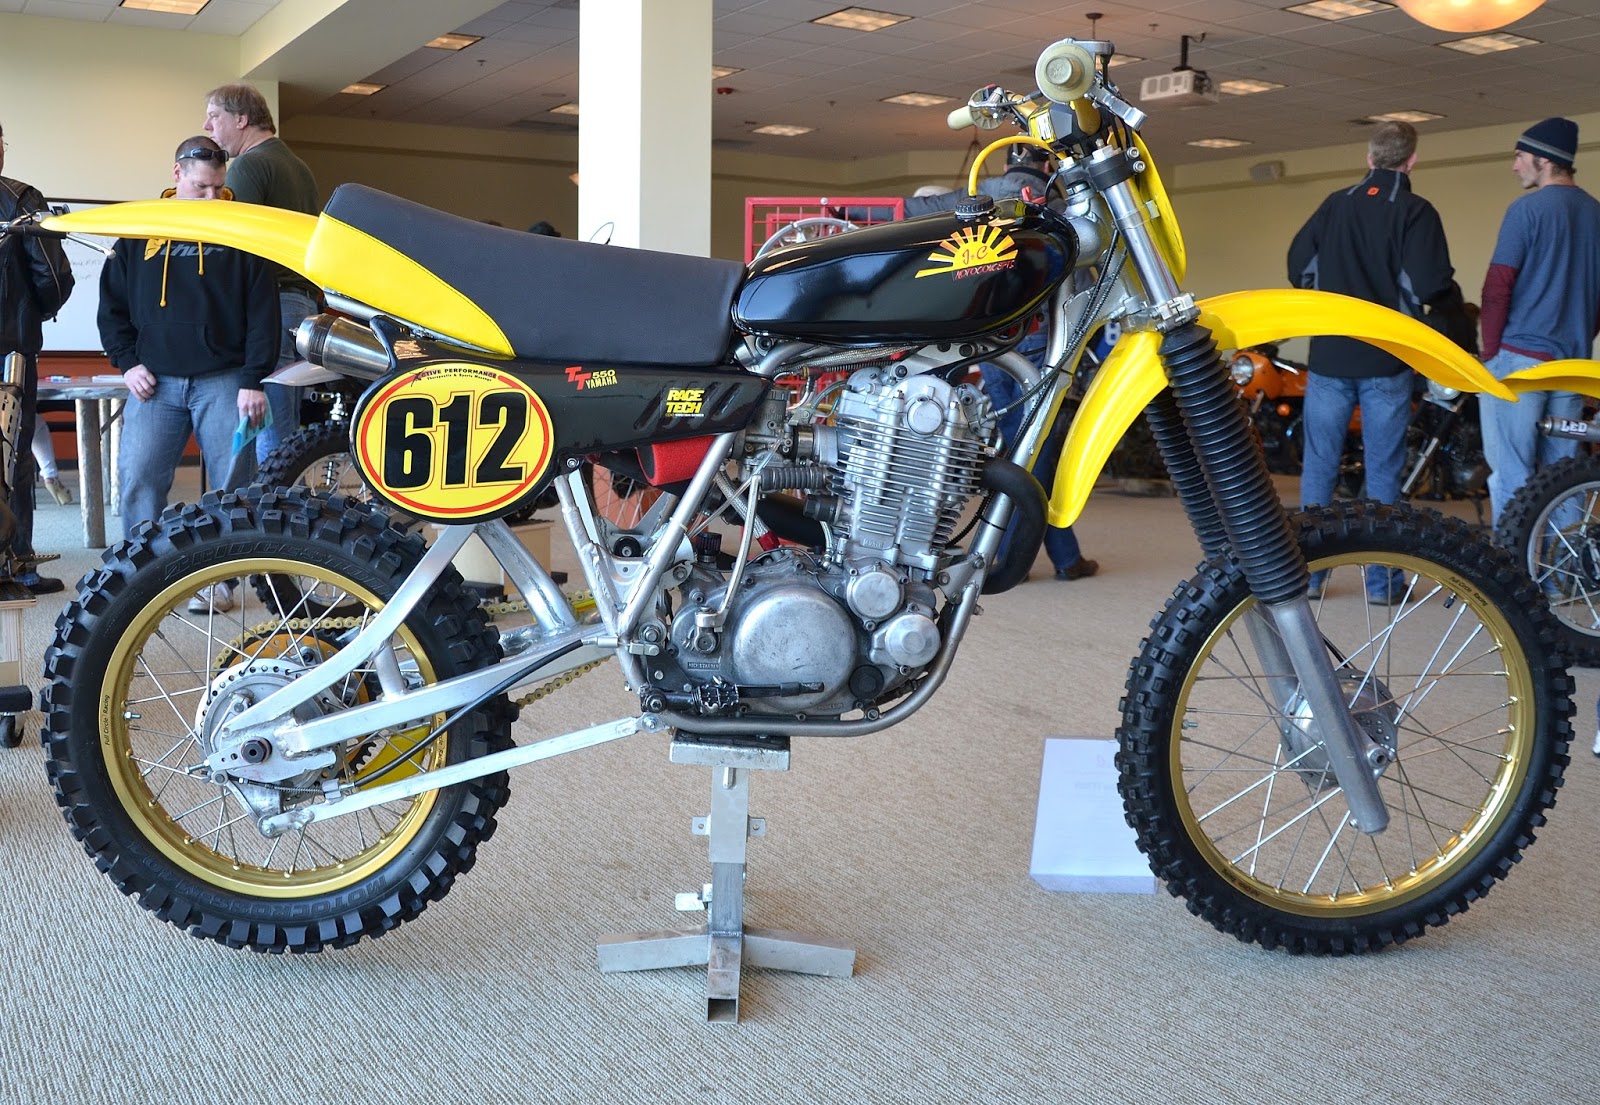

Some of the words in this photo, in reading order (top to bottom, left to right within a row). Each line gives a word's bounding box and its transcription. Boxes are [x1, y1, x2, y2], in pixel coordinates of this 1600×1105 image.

[160, 243, 225, 257] thor
[955, 260, 1016, 280] MOTOCONCEPTS
[444, 368, 497, 379] PERFORMANCE
[564, 366, 592, 391] TT
[592, 369, 616, 380] 550
[585, 376, 618, 390] YAMAHA
[666, 389, 705, 401] RACE
[665, 401, 703, 413] TECH
[383, 391, 527, 489] 612
[1458, 581, 1473, 593] Circle
[1474, 591, 1488, 607] Racing
[102, 694, 110, 714] Racing
